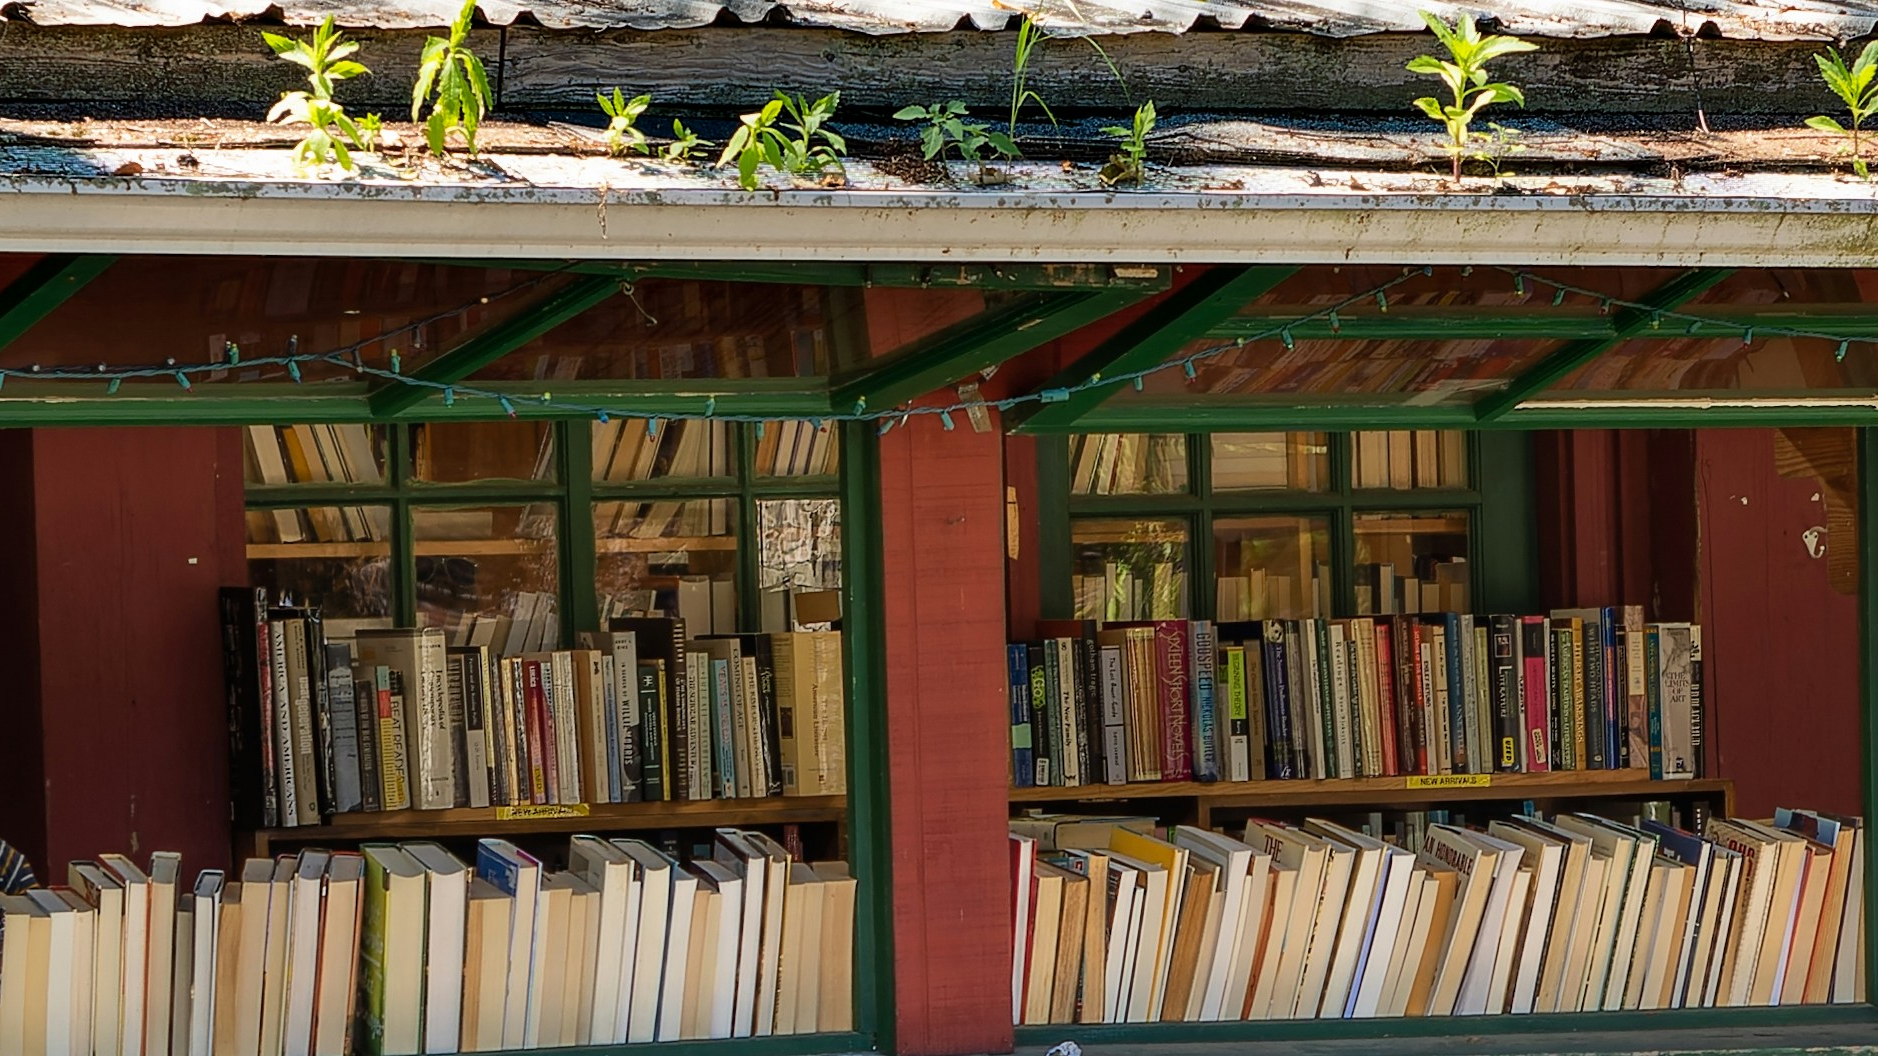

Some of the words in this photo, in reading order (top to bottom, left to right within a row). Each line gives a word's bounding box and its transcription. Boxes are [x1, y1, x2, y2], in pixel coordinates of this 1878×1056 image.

[1086, 639, 1097, 671] gotham
[1158, 630, 1186, 675] SIXTEEN
[1588, 628, 1596, 654] WITH
[274, 630, 286, 692] AMERICA
[732, 648, 742, 692] COMING
[1196, 633, 1213, 690] GODSPEED
[1231, 653, 1241, 690] BEGINNING
[1335, 641, 1343, 687] Readings
[1574, 642, 1583, 685] LITERARY
[435, 669, 444, 720] Encyclopedia
[735, 694, 742, 710] OF
[1063, 691, 1071, 704] The
[1089, 673, 1097, 697] tragic
[1161, 675, 1188, 712] SHORT
[1498, 665, 1513, 718] LITERATURE
[1670, 695, 1686, 703] ART
[280, 701, 289, 731] AND
[736, 711, 744, 731] AGE
[1202, 696, 1213, 732] NICKOLAS
[1233, 691, 1242, 717] THEORY
[1575, 687, 1585, 744] AWAKENINGS
[1064, 723, 1072, 747] Family
[1164, 715, 1189, 760] NOVELS
[1203, 736, 1213, 763] BUTLER
[282, 736, 294, 817] AMERICANS
[1420, 778, 1438, 786] NEW
[1440, 777, 1477, 785] ARRIVALS
[1263, 834, 1284, 864] THE
[1422, 834, 1435, 855] AN
[1435, 841, 1474, 876] HONORABLE
